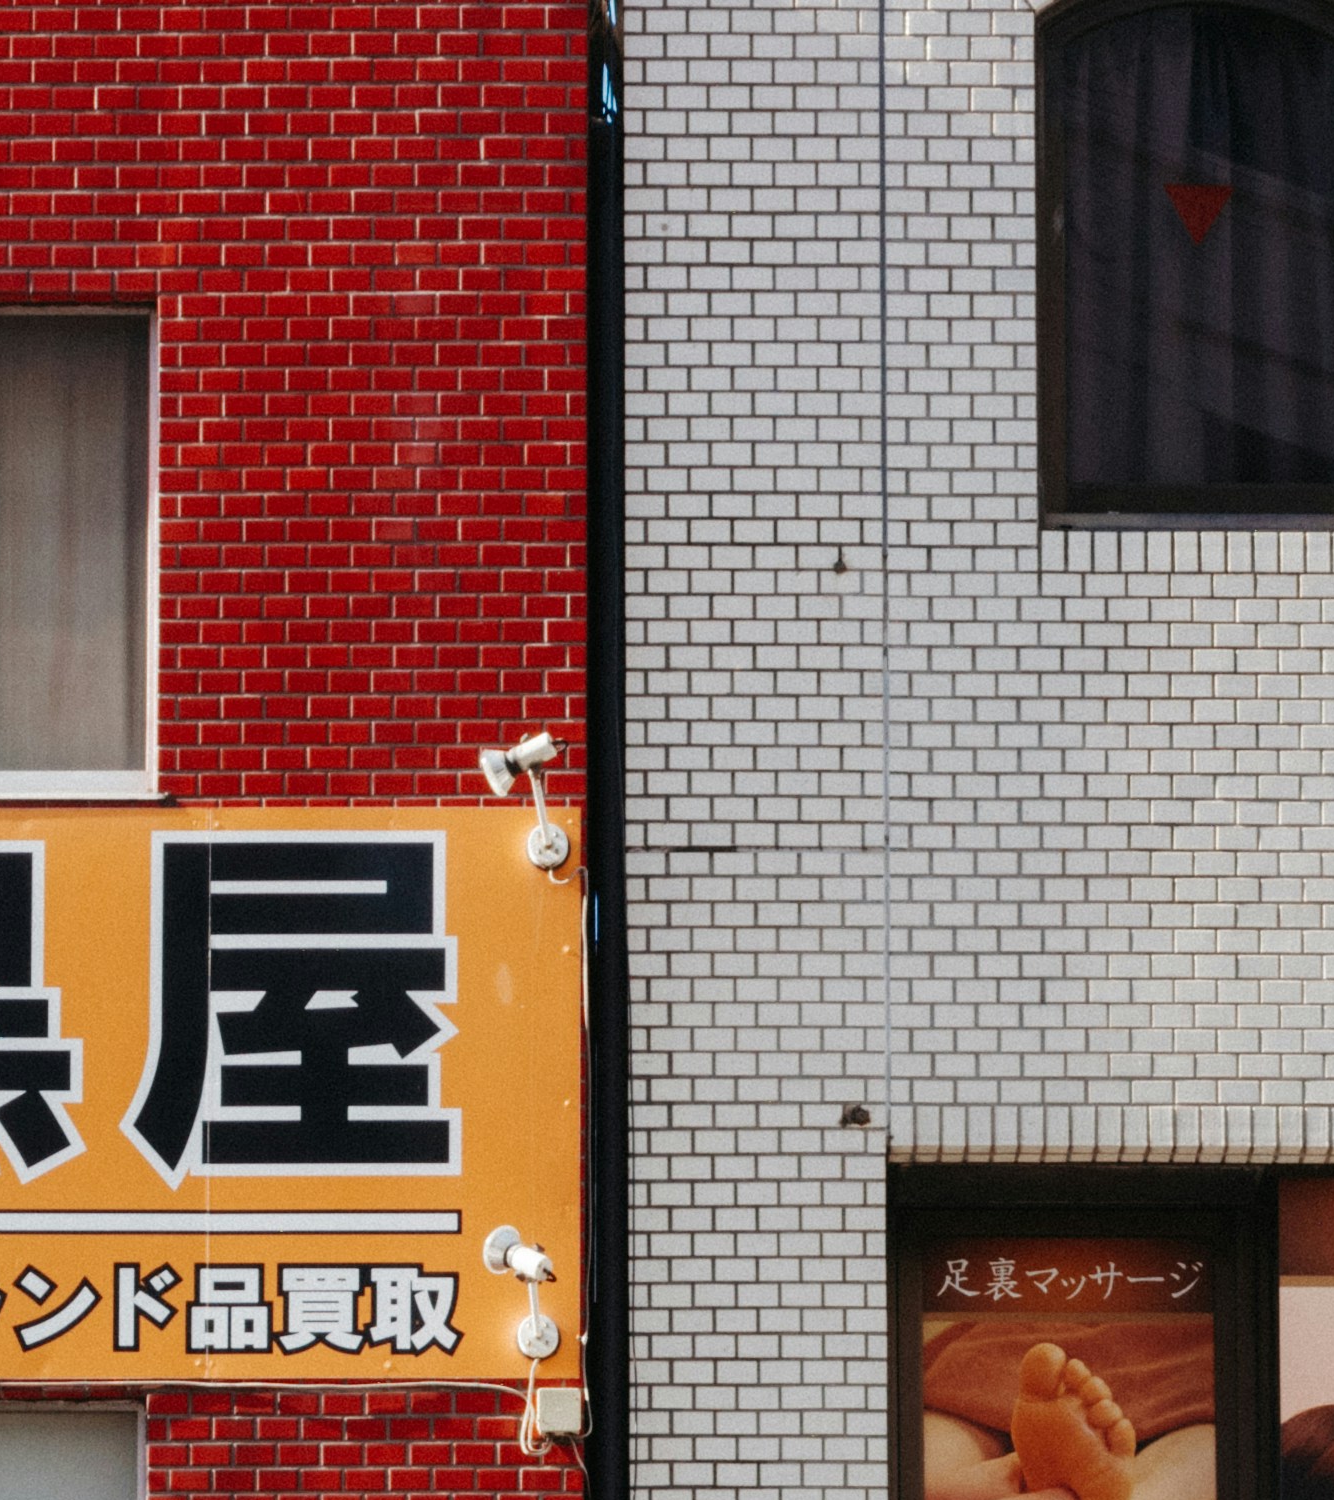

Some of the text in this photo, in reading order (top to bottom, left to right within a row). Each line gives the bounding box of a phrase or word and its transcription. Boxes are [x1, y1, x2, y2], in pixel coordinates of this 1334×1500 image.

[937, 1257, 1204, 1301] 足裏マッサージ
